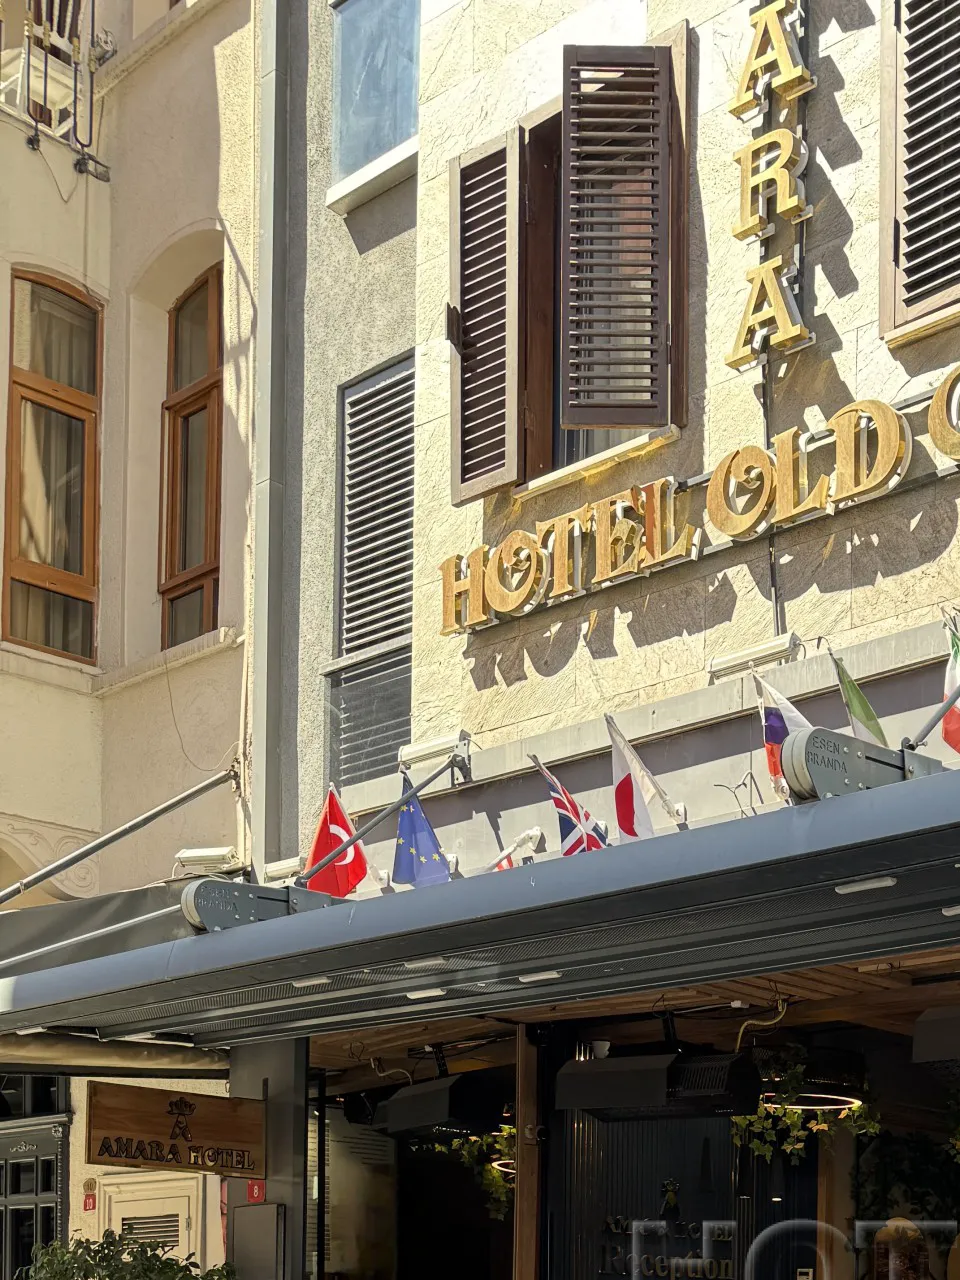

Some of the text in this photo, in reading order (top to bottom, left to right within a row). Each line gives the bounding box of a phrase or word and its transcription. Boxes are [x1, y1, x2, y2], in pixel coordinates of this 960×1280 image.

[438, 476, 702, 636] HOTEL
[704, 400, 912, 543] OLD
[812, 735, 841, 755] ESEN
[806, 750, 848, 774] BRANDA
[98, 1136, 255, 1171] AMARA HOTEL
[253, 1185, 259, 1198] 8
[86, 1198, 93, 1210] 10
